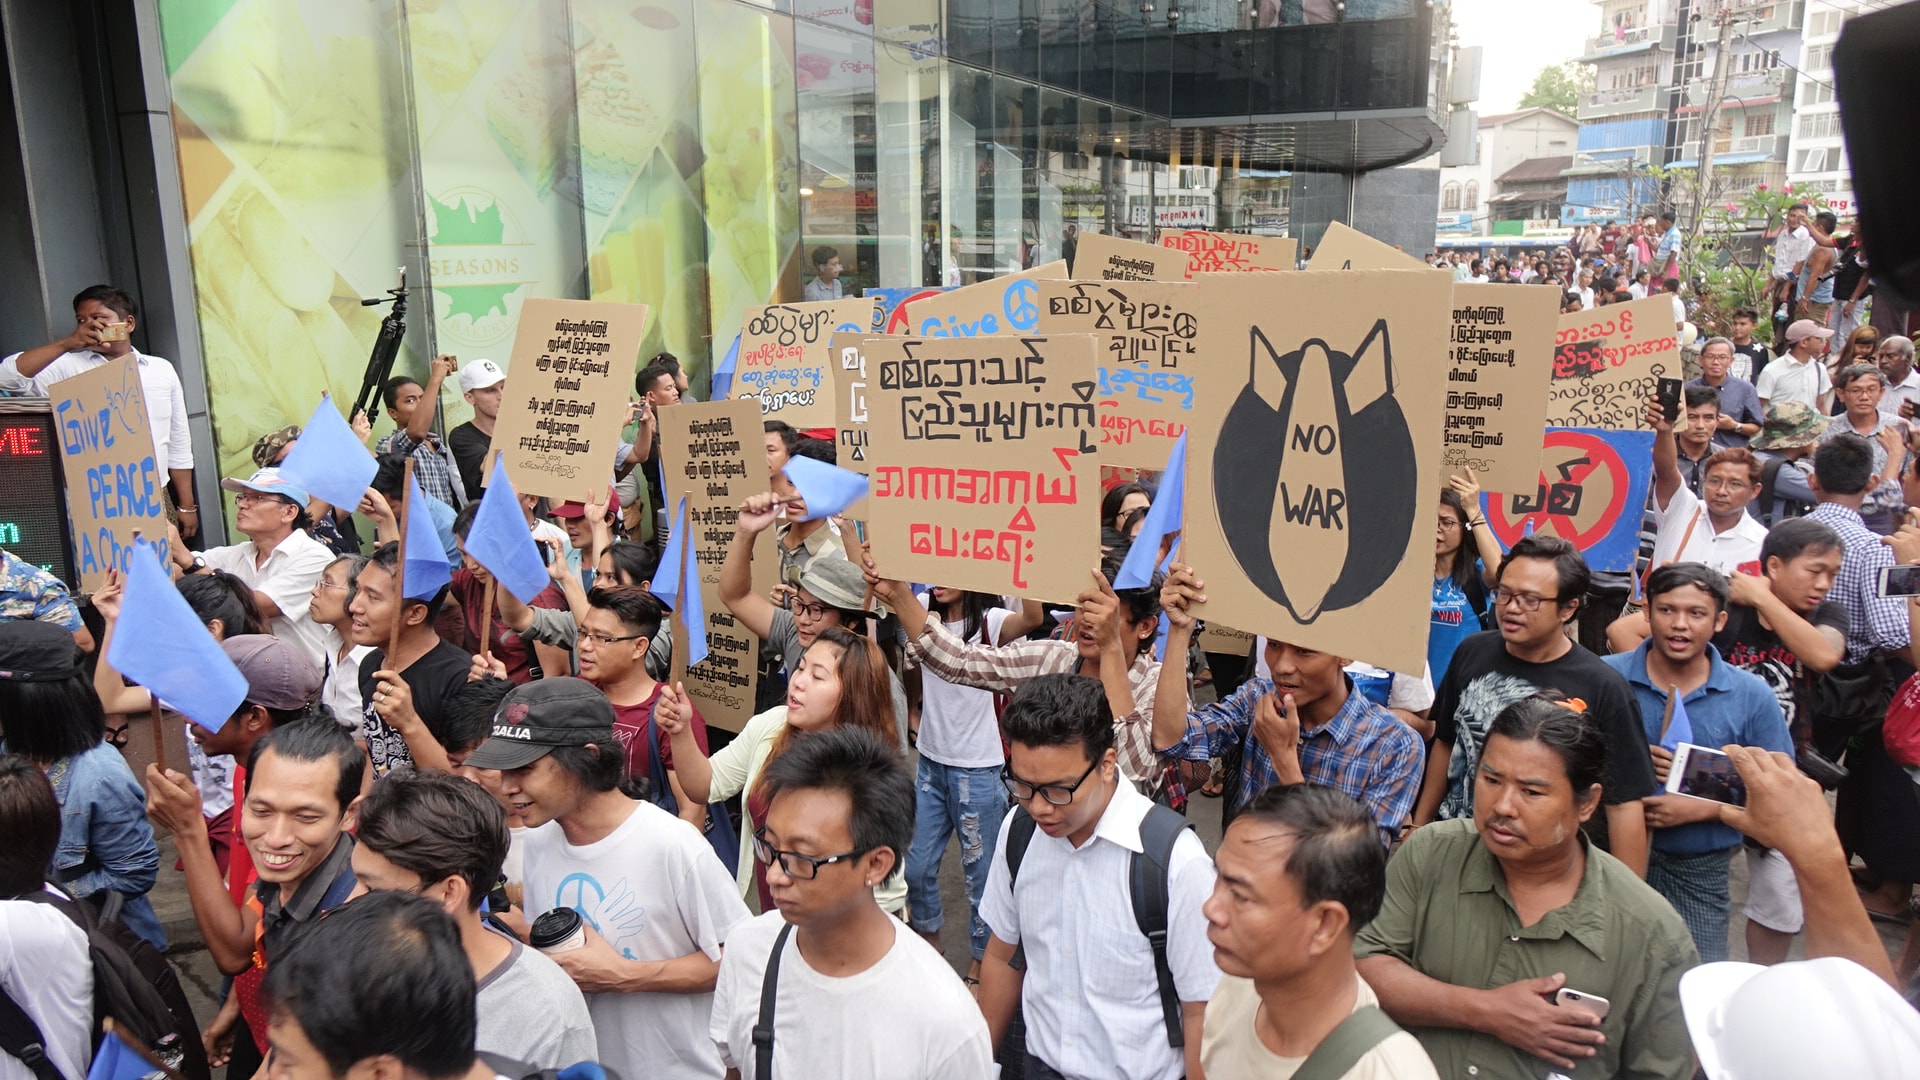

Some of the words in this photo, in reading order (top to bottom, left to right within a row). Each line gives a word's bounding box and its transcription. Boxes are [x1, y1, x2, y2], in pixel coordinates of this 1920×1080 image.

[429, 257, 520, 277] SEASONS
[921, 313, 999, 338] Give
[57, 398, 115, 456] Give
[1291, 424, 1336, 455] NO
[87, 456, 161, 519] PEACE
[1280, 481, 1346, 531] WAR
[82, 531, 98, 574] A
[1437, 610, 1463, 623] WAR
